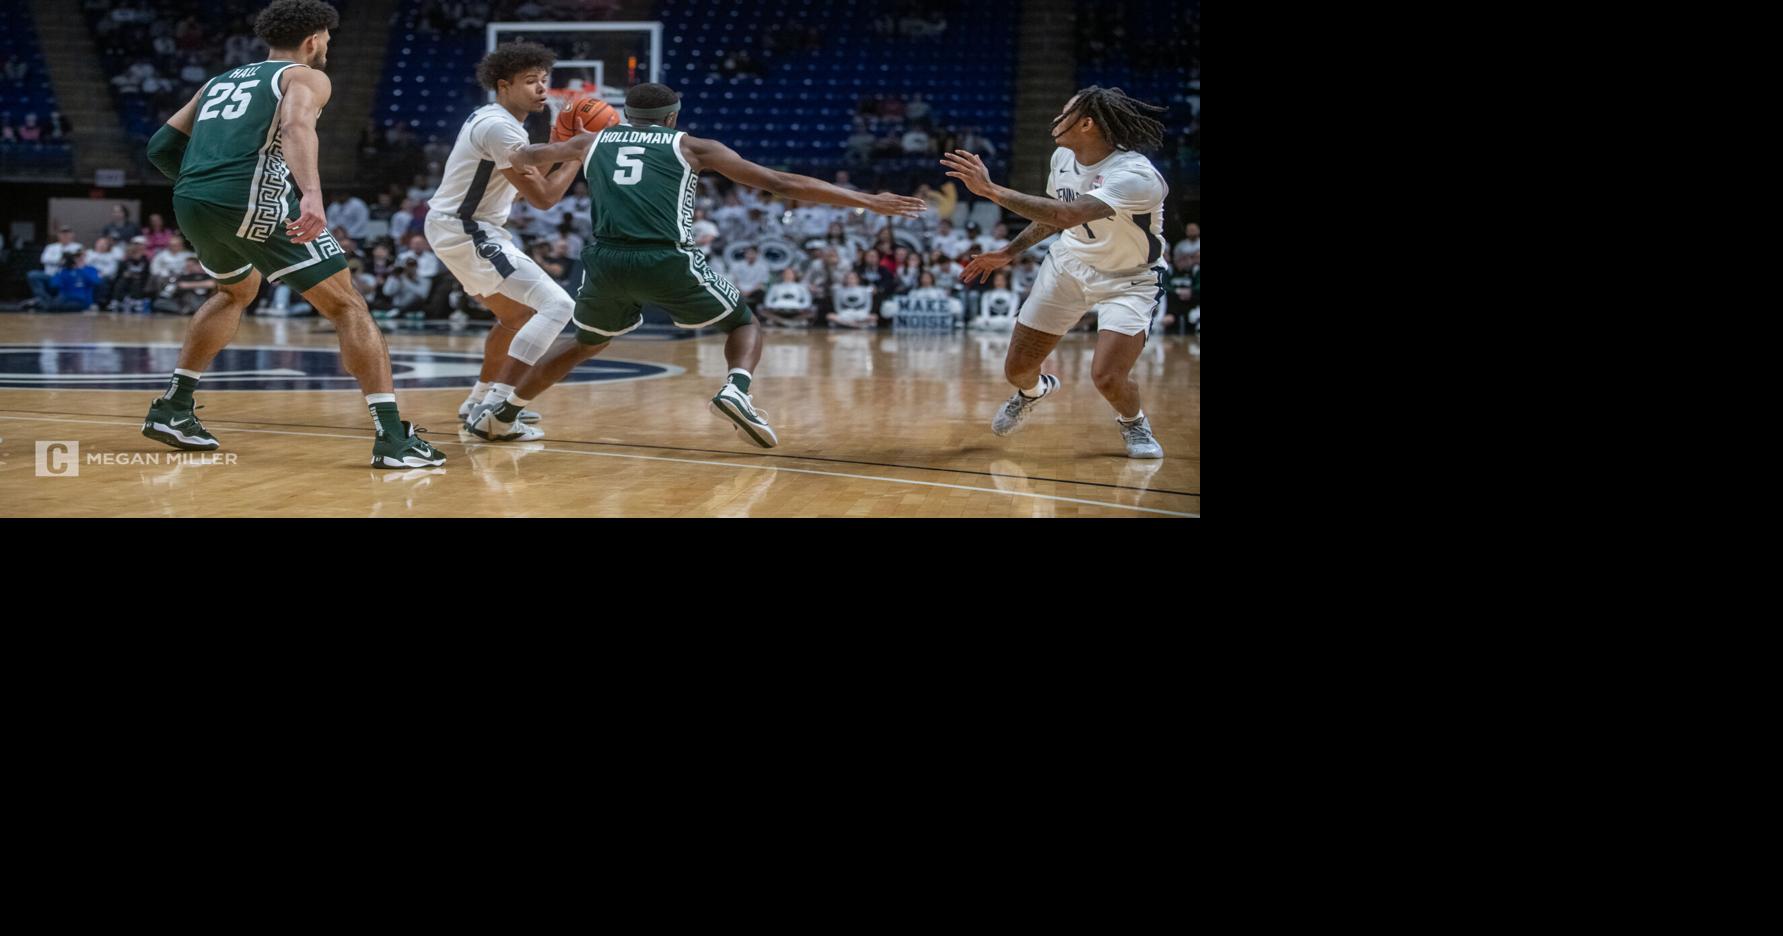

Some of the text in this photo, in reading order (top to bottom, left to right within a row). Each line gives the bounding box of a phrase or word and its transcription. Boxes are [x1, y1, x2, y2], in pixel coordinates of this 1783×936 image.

[229, 65, 262, 79] HALL
[197, 80, 261, 122] 25
[600, 131, 674, 144] HOLLOMAN
[613, 146, 646, 185] 5
[899, 299, 950, 313] MAKE
[897, 315, 951, 329] NOISE
